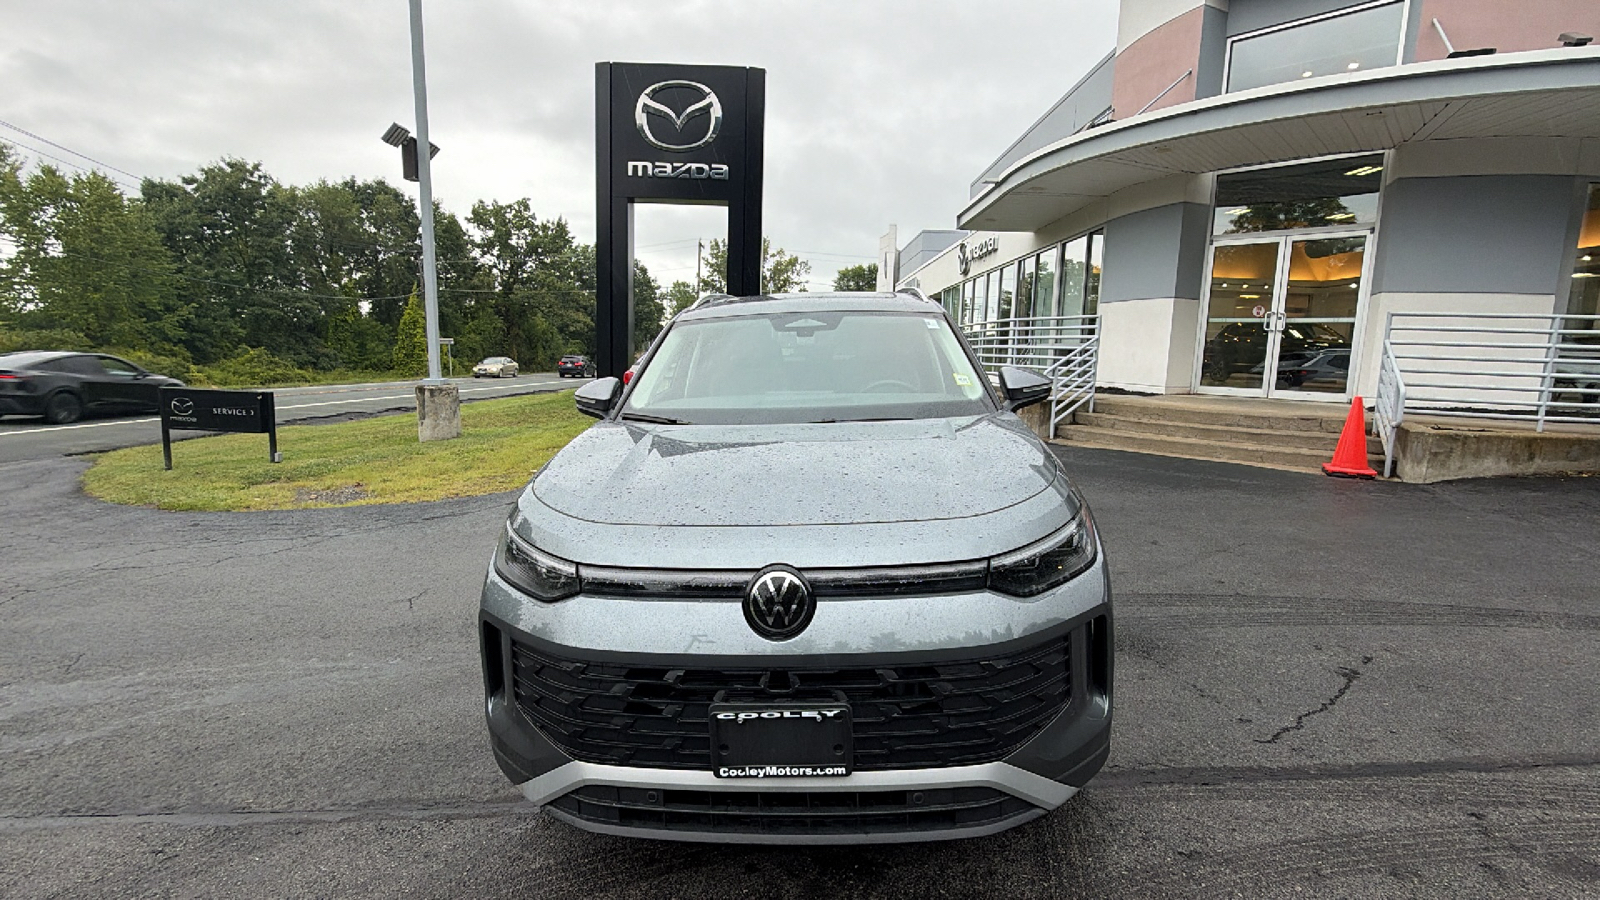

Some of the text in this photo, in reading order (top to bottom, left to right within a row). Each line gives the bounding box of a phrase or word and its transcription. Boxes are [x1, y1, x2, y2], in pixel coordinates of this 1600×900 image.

[627, 161, 729, 180] mazda
[212, 407, 247, 416] SERVICE
[717, 710, 841, 719] COOLEY
